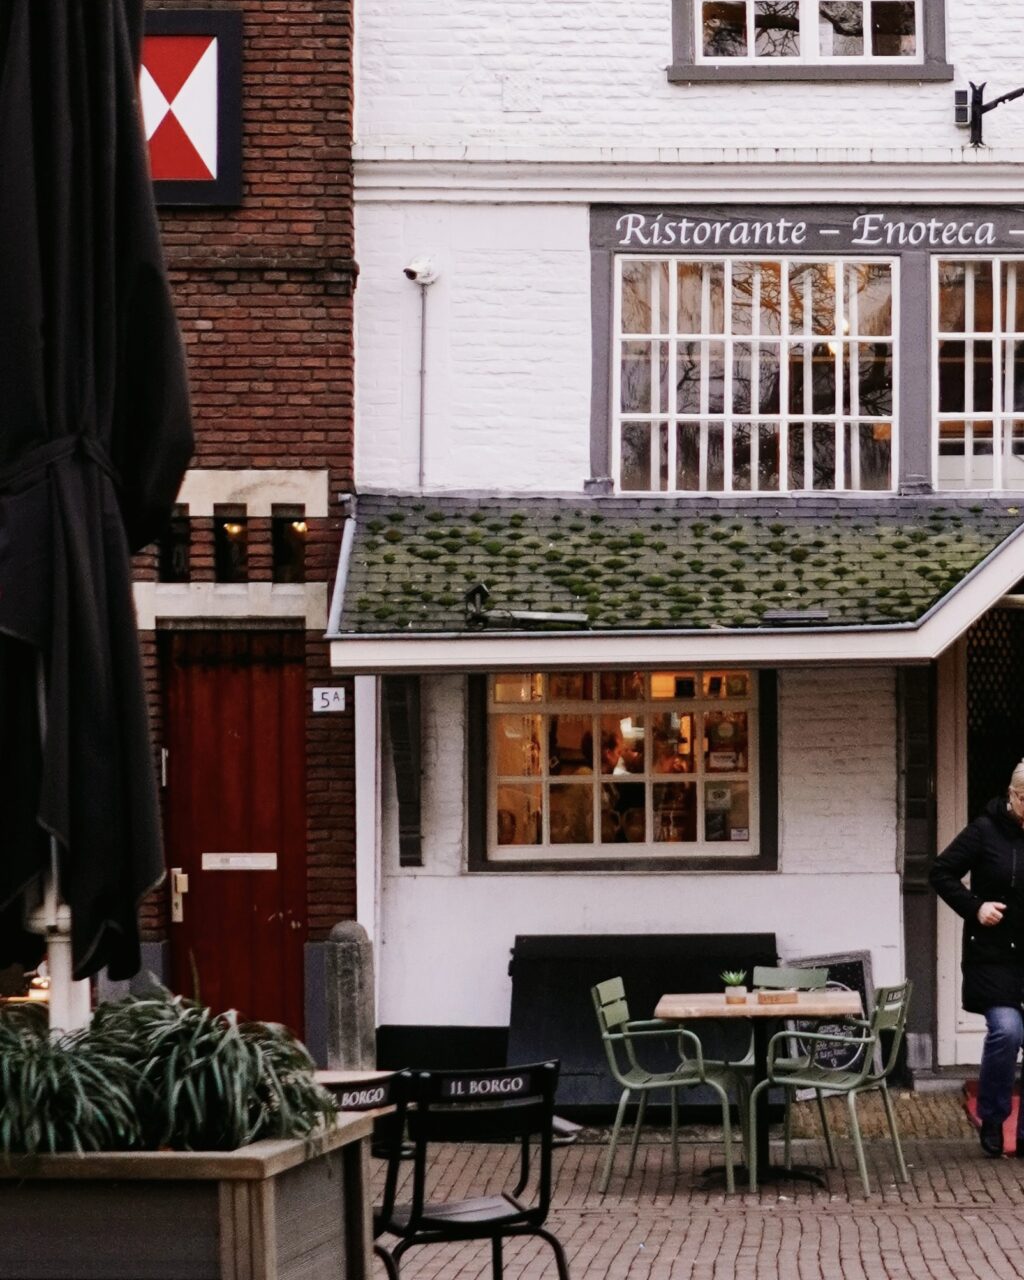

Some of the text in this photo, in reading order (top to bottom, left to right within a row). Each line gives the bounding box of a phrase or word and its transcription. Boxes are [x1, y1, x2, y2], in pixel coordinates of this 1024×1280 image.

[615, 213, 806, 245] Ristorante
[851, 213, 996, 245] Enoteca
[320, 691, 340, 708] 5A
[450, 1076, 524, 1095] IL BORGO
[341, 1087, 385, 1106] BORGO
